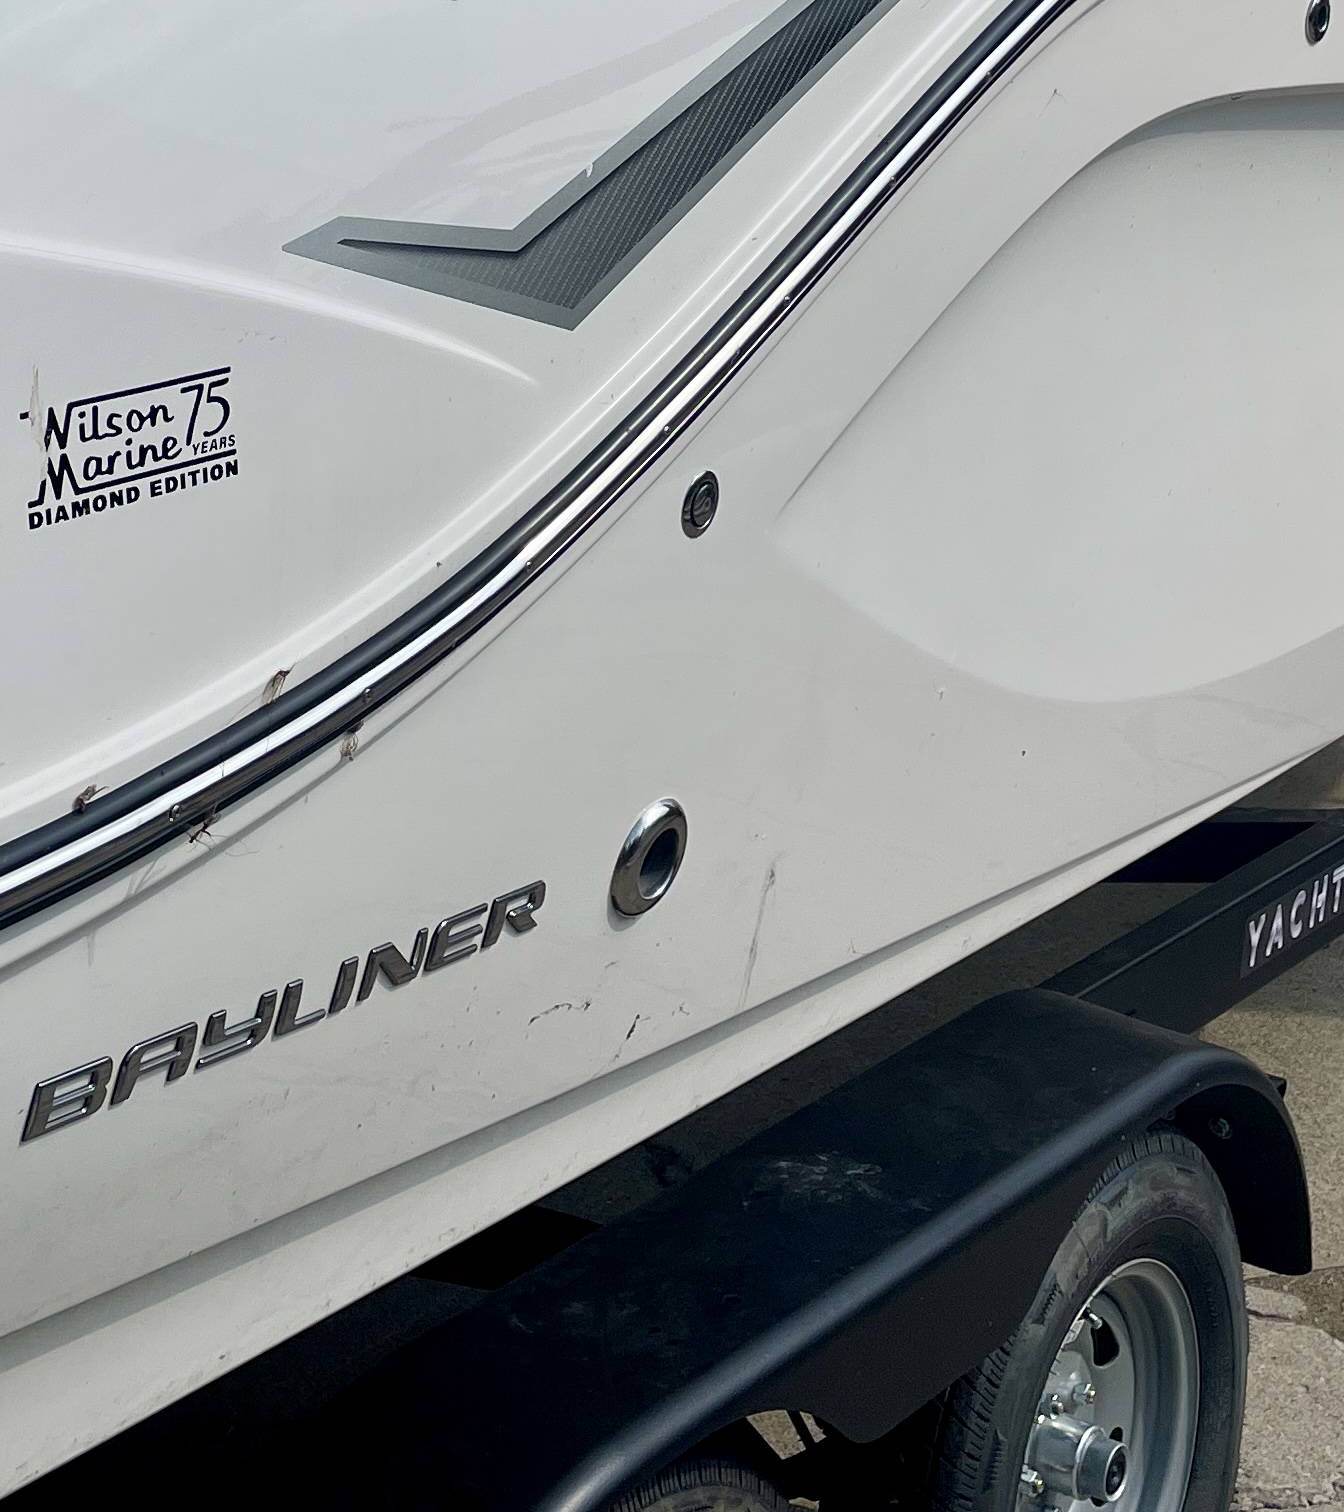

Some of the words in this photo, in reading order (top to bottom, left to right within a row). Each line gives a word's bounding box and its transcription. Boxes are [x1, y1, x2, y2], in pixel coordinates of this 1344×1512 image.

[180, 377, 230, 447] 75
[28, 436, 183, 509] Marine
[192, 434, 236, 456] YEARS
[28, 486, 141, 530] DIAMOND
[150, 458, 239, 498] EDITION
[19, 879, 547, 1146] BAYLINER
